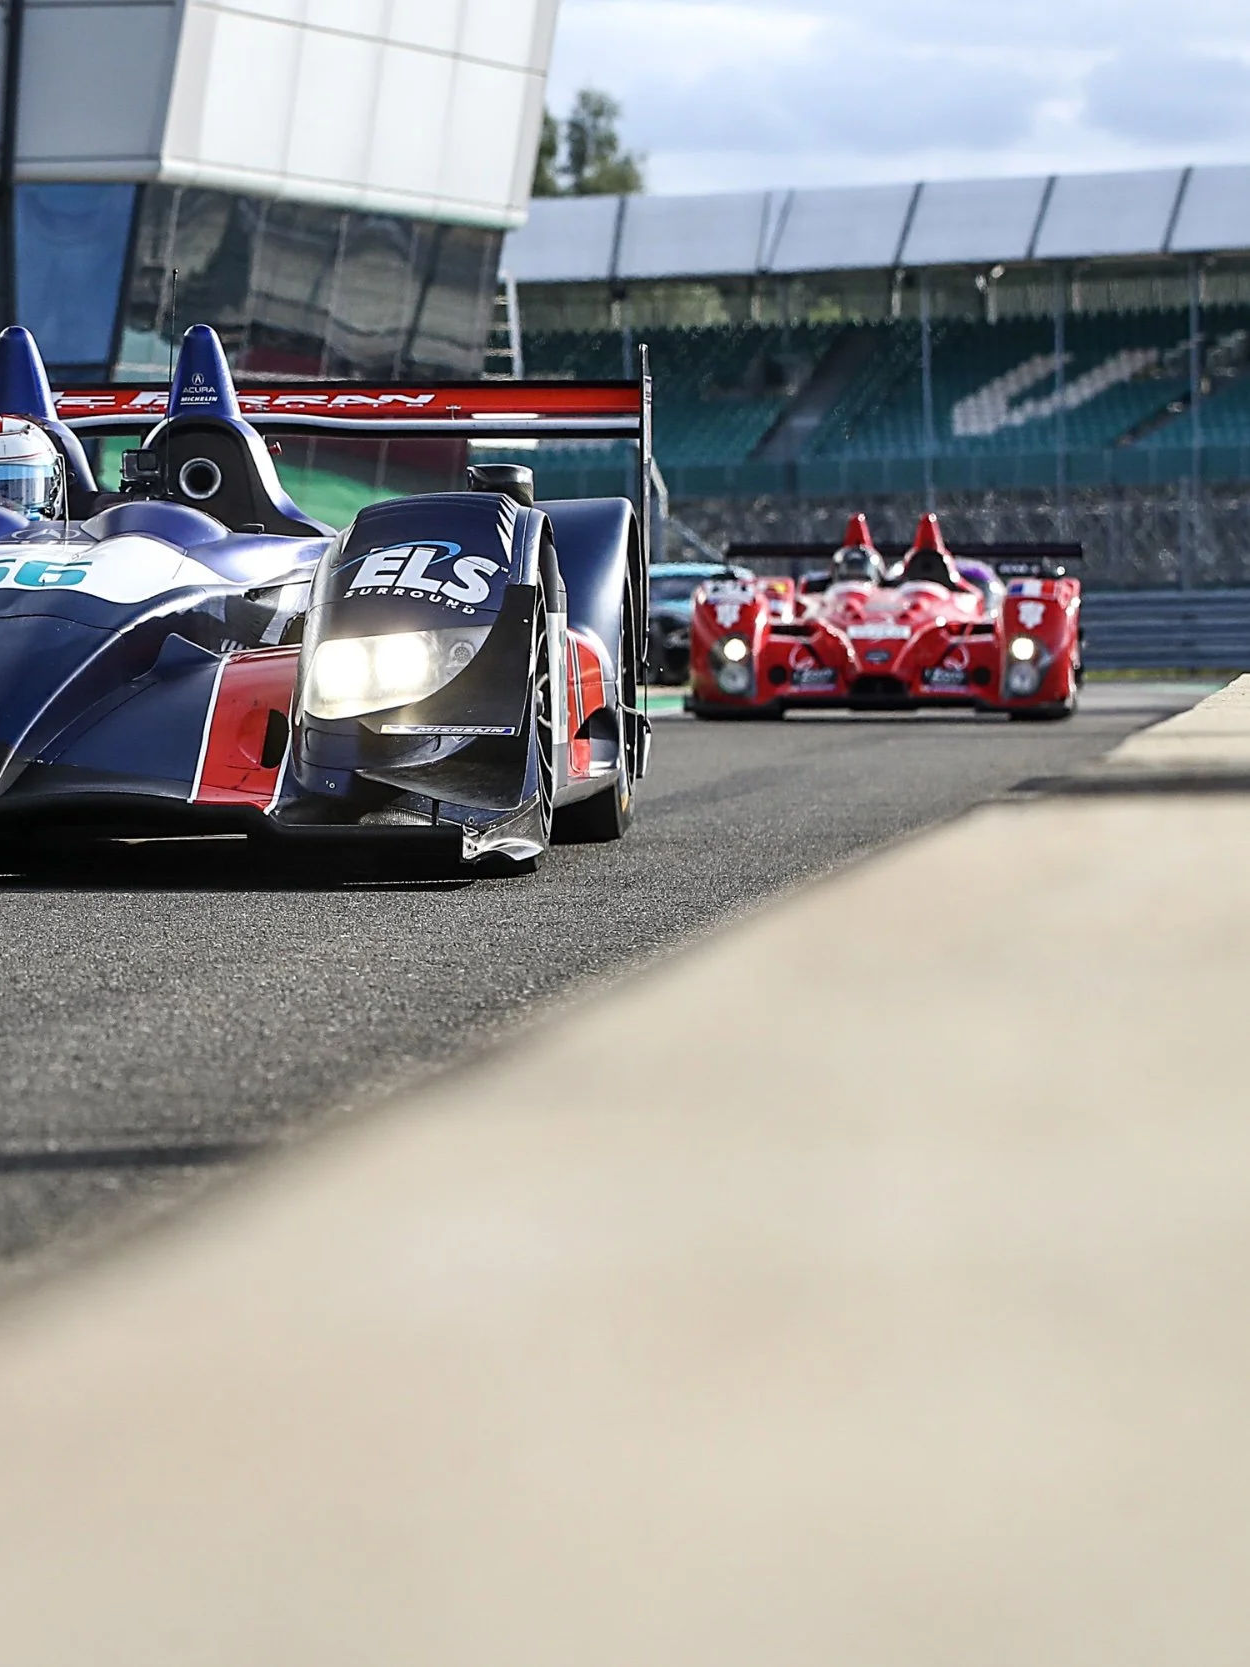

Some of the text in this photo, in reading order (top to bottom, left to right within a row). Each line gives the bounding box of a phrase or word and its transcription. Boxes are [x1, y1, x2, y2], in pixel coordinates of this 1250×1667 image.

[350, 547, 501, 604] ELS
[343, 586, 476, 615] SURROUND
[415, 726, 507, 734] MICHELIN
